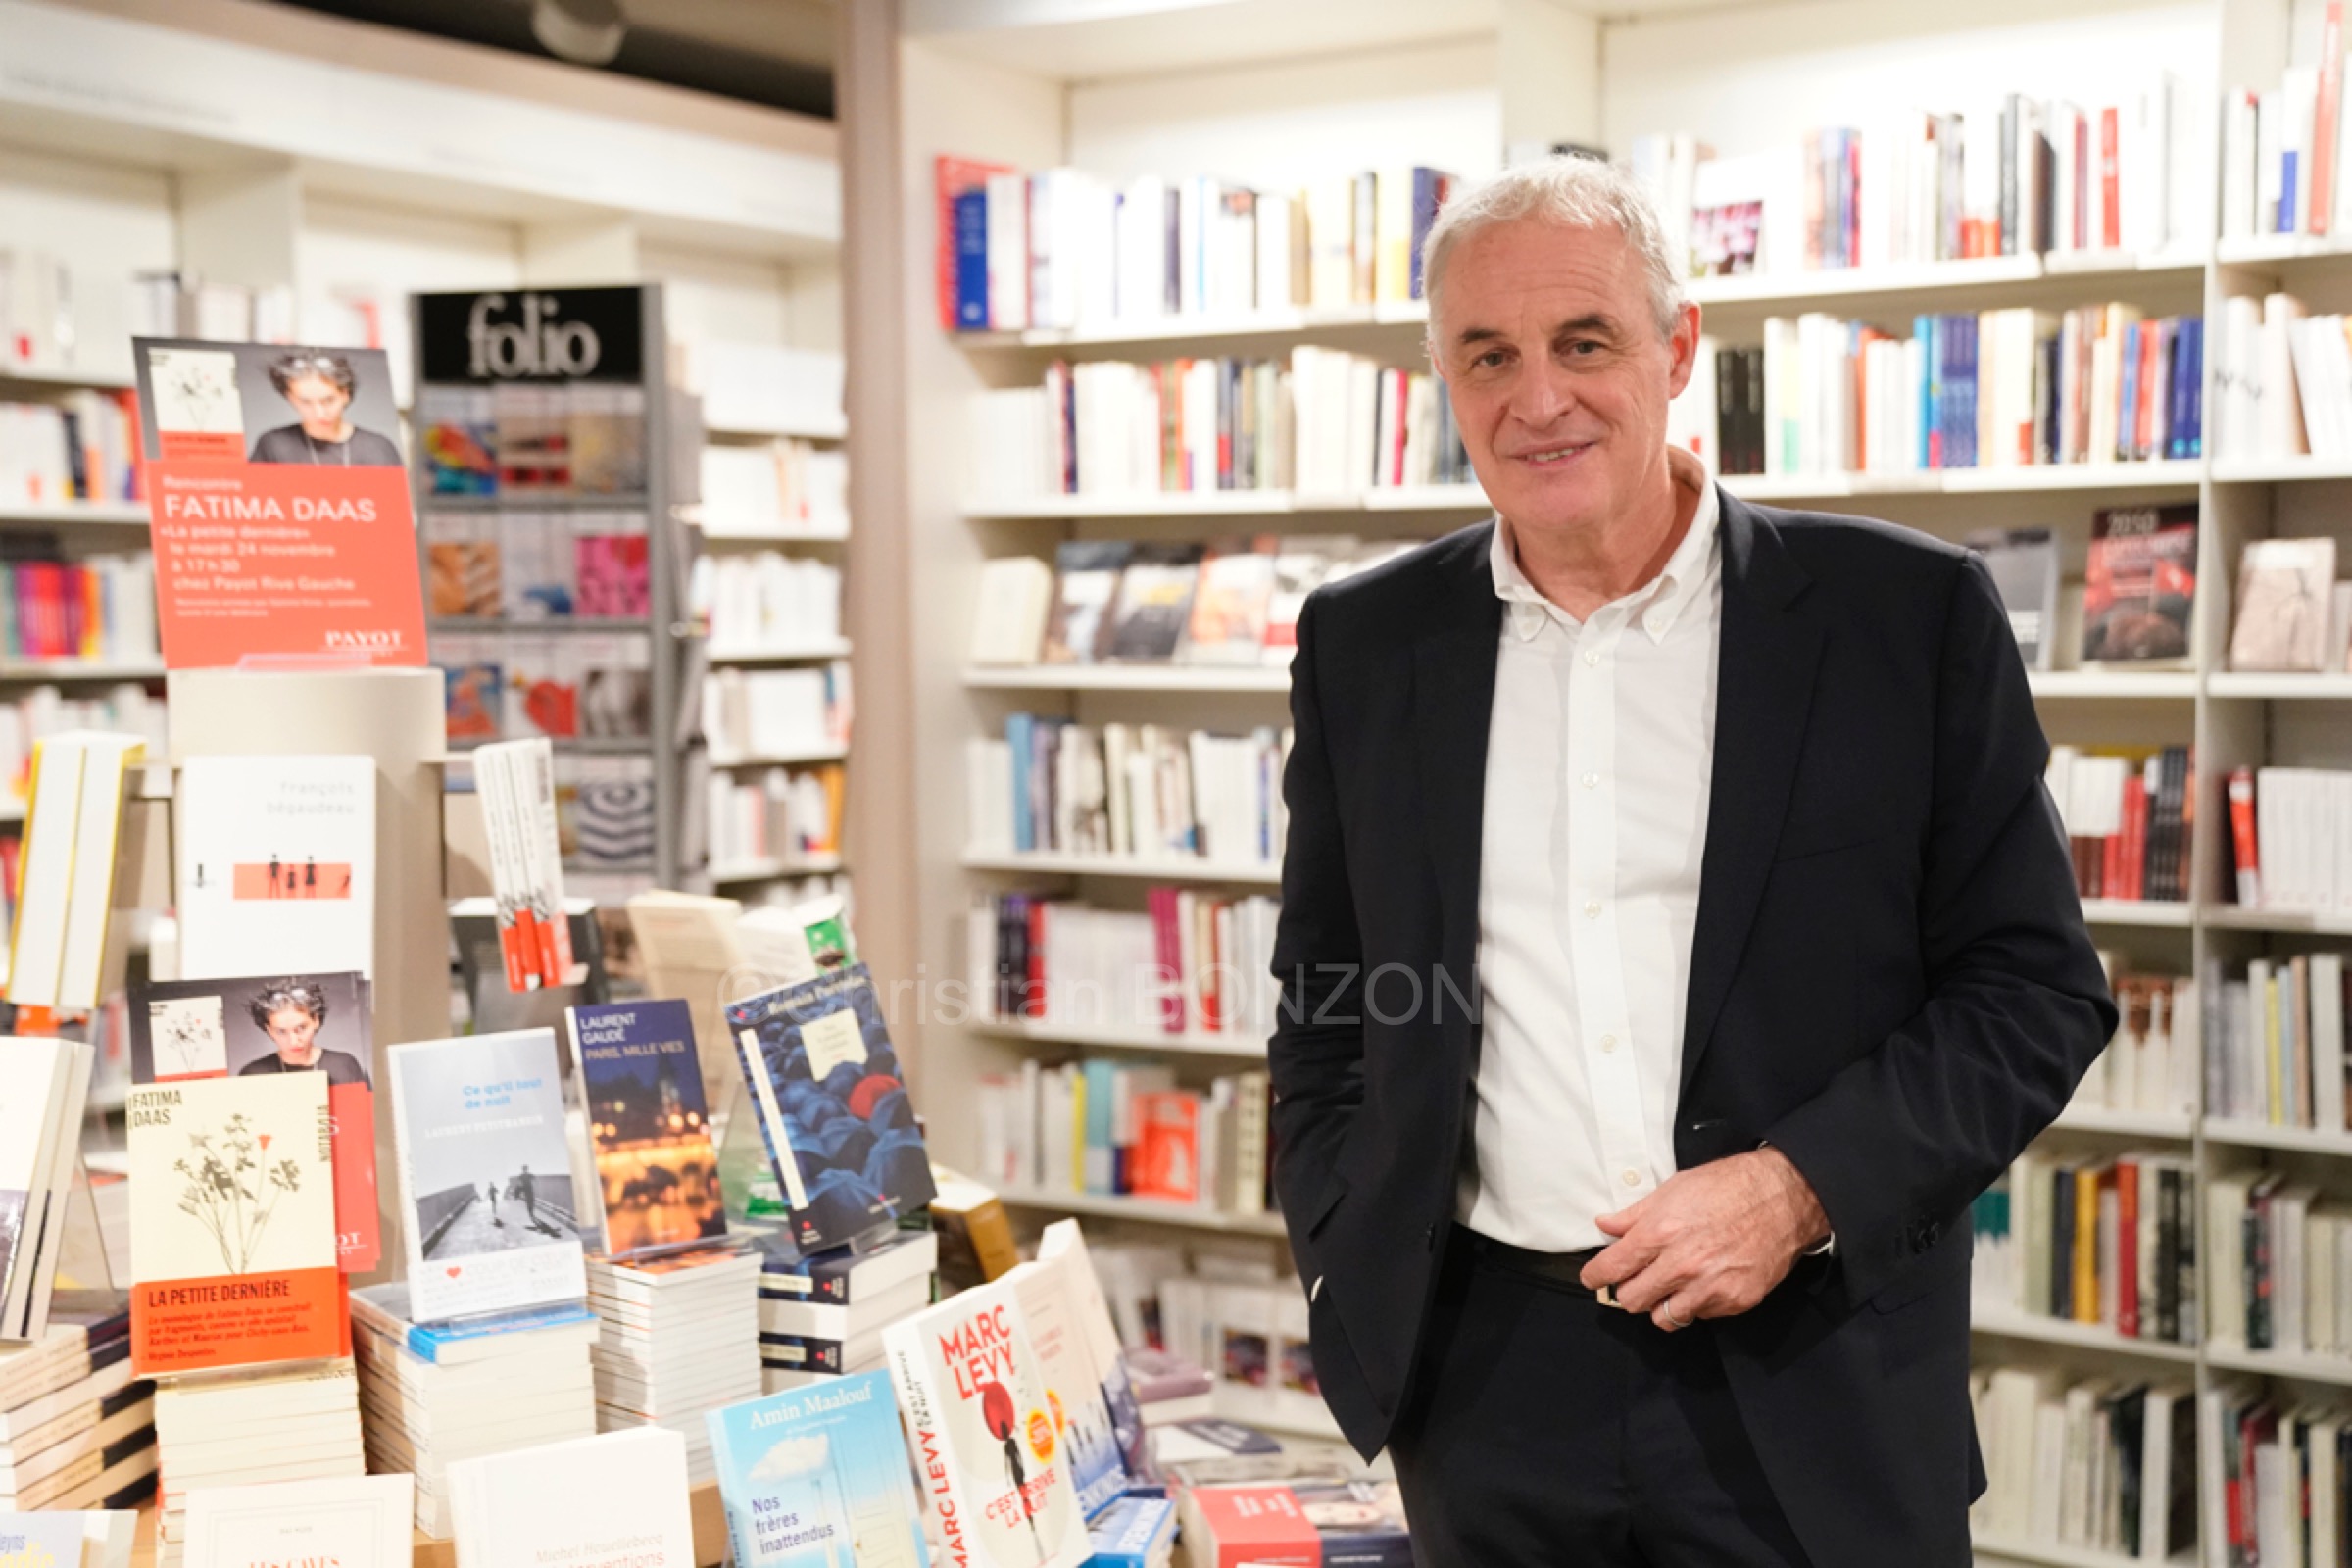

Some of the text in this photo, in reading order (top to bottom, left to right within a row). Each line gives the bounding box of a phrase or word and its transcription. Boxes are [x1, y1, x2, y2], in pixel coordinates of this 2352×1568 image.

[466, 292, 601, 378] folio
[163, 475, 242, 491] Rencontre
[164, 494, 377, 522] FATIMA DAAS
[191, 525, 235, 541] petite
[188, 543, 232, 556] mardi
[238, 543, 257, 556] 24
[260, 544, 335, 557] novembre
[325, 630, 402, 647] PAYOT
[579, 1013, 636, 1030] LAURENT
[582, 1028, 625, 1044] GAUDÉ
[623, 1043, 659, 1057] MILLE
[660, 1040, 685, 1054] VIES
[131, 1089, 183, 1110] FATIMA
[133, 1109, 172, 1128] DAAS
[148, 1278, 291, 1308] LA PETITE DERNIÈRE
[939, 1304, 1010, 1366] MARC
[954, 1341, 1015, 1400] LEVY
[750, 1402, 801, 1430] Amin
[803, 1380, 872, 1416] Maalouf
[752, 1496, 781, 1514] Nos
[918, 1430, 968, 1568] MARC LEVY
[756, 1512, 799, 1535] frères
[760, 1523, 834, 1555] inattendus
